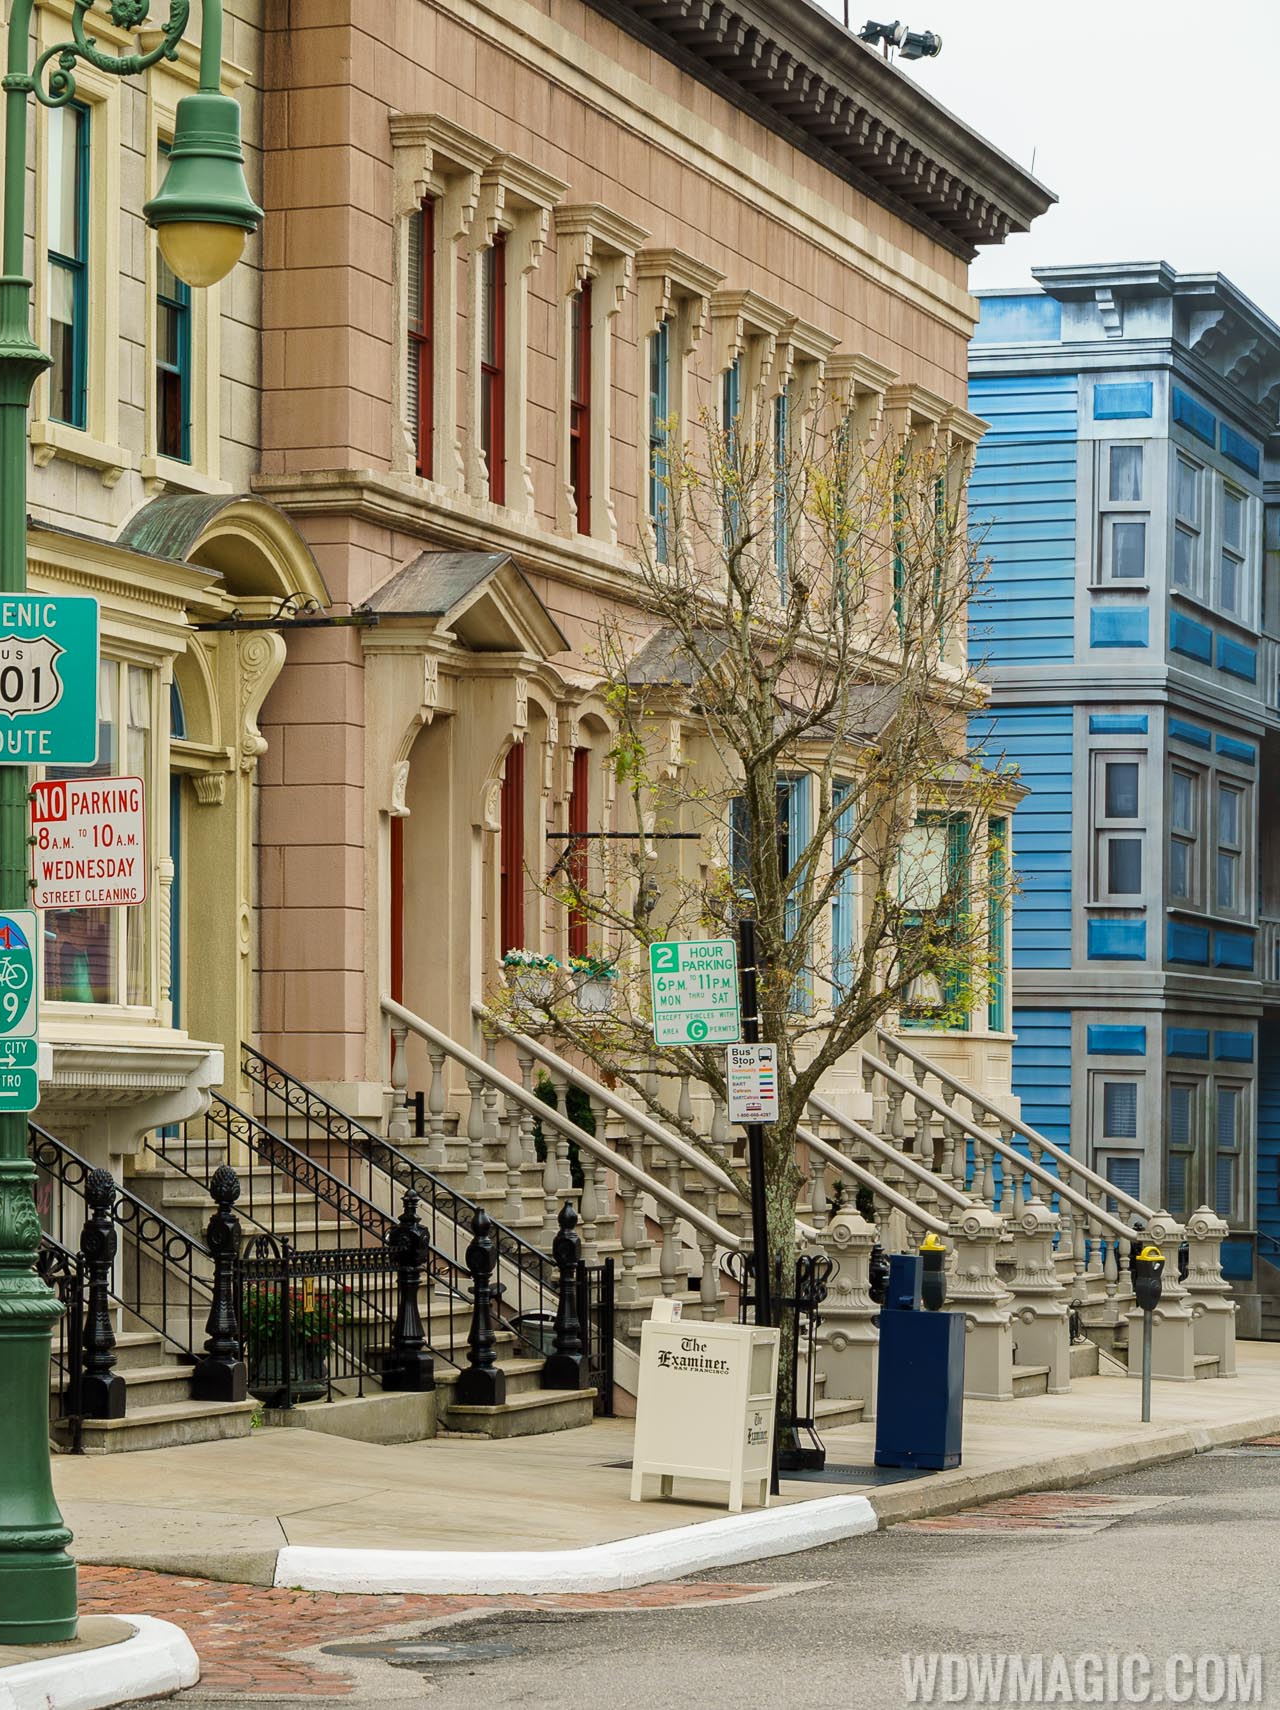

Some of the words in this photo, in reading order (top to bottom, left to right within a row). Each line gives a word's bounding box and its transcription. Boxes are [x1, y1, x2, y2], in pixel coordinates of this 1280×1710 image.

[35, 786, 65, 819] NO
[71, 789, 139, 815] PARKING
[78, 828, 88, 838] TO
[42, 858, 135, 881] WEDNESDAY
[42, 890, 81, 904] STREET
[85, 888, 137, 901] CLEANING
[656, 947, 674, 968] 2
[689, 946, 723, 958] HOUR
[682, 959, 733, 971] PARKING
[660, 995, 681, 1006] MON
[711, 992, 729, 1004] SAT
[691, 1022, 704, 1038] G
[5, 1041, 29, 1054] CITY
[732, 1048, 751, 1056] Bus
[732, 1056, 755, 1066] Stop
[680, 1337, 707, 1352] The
